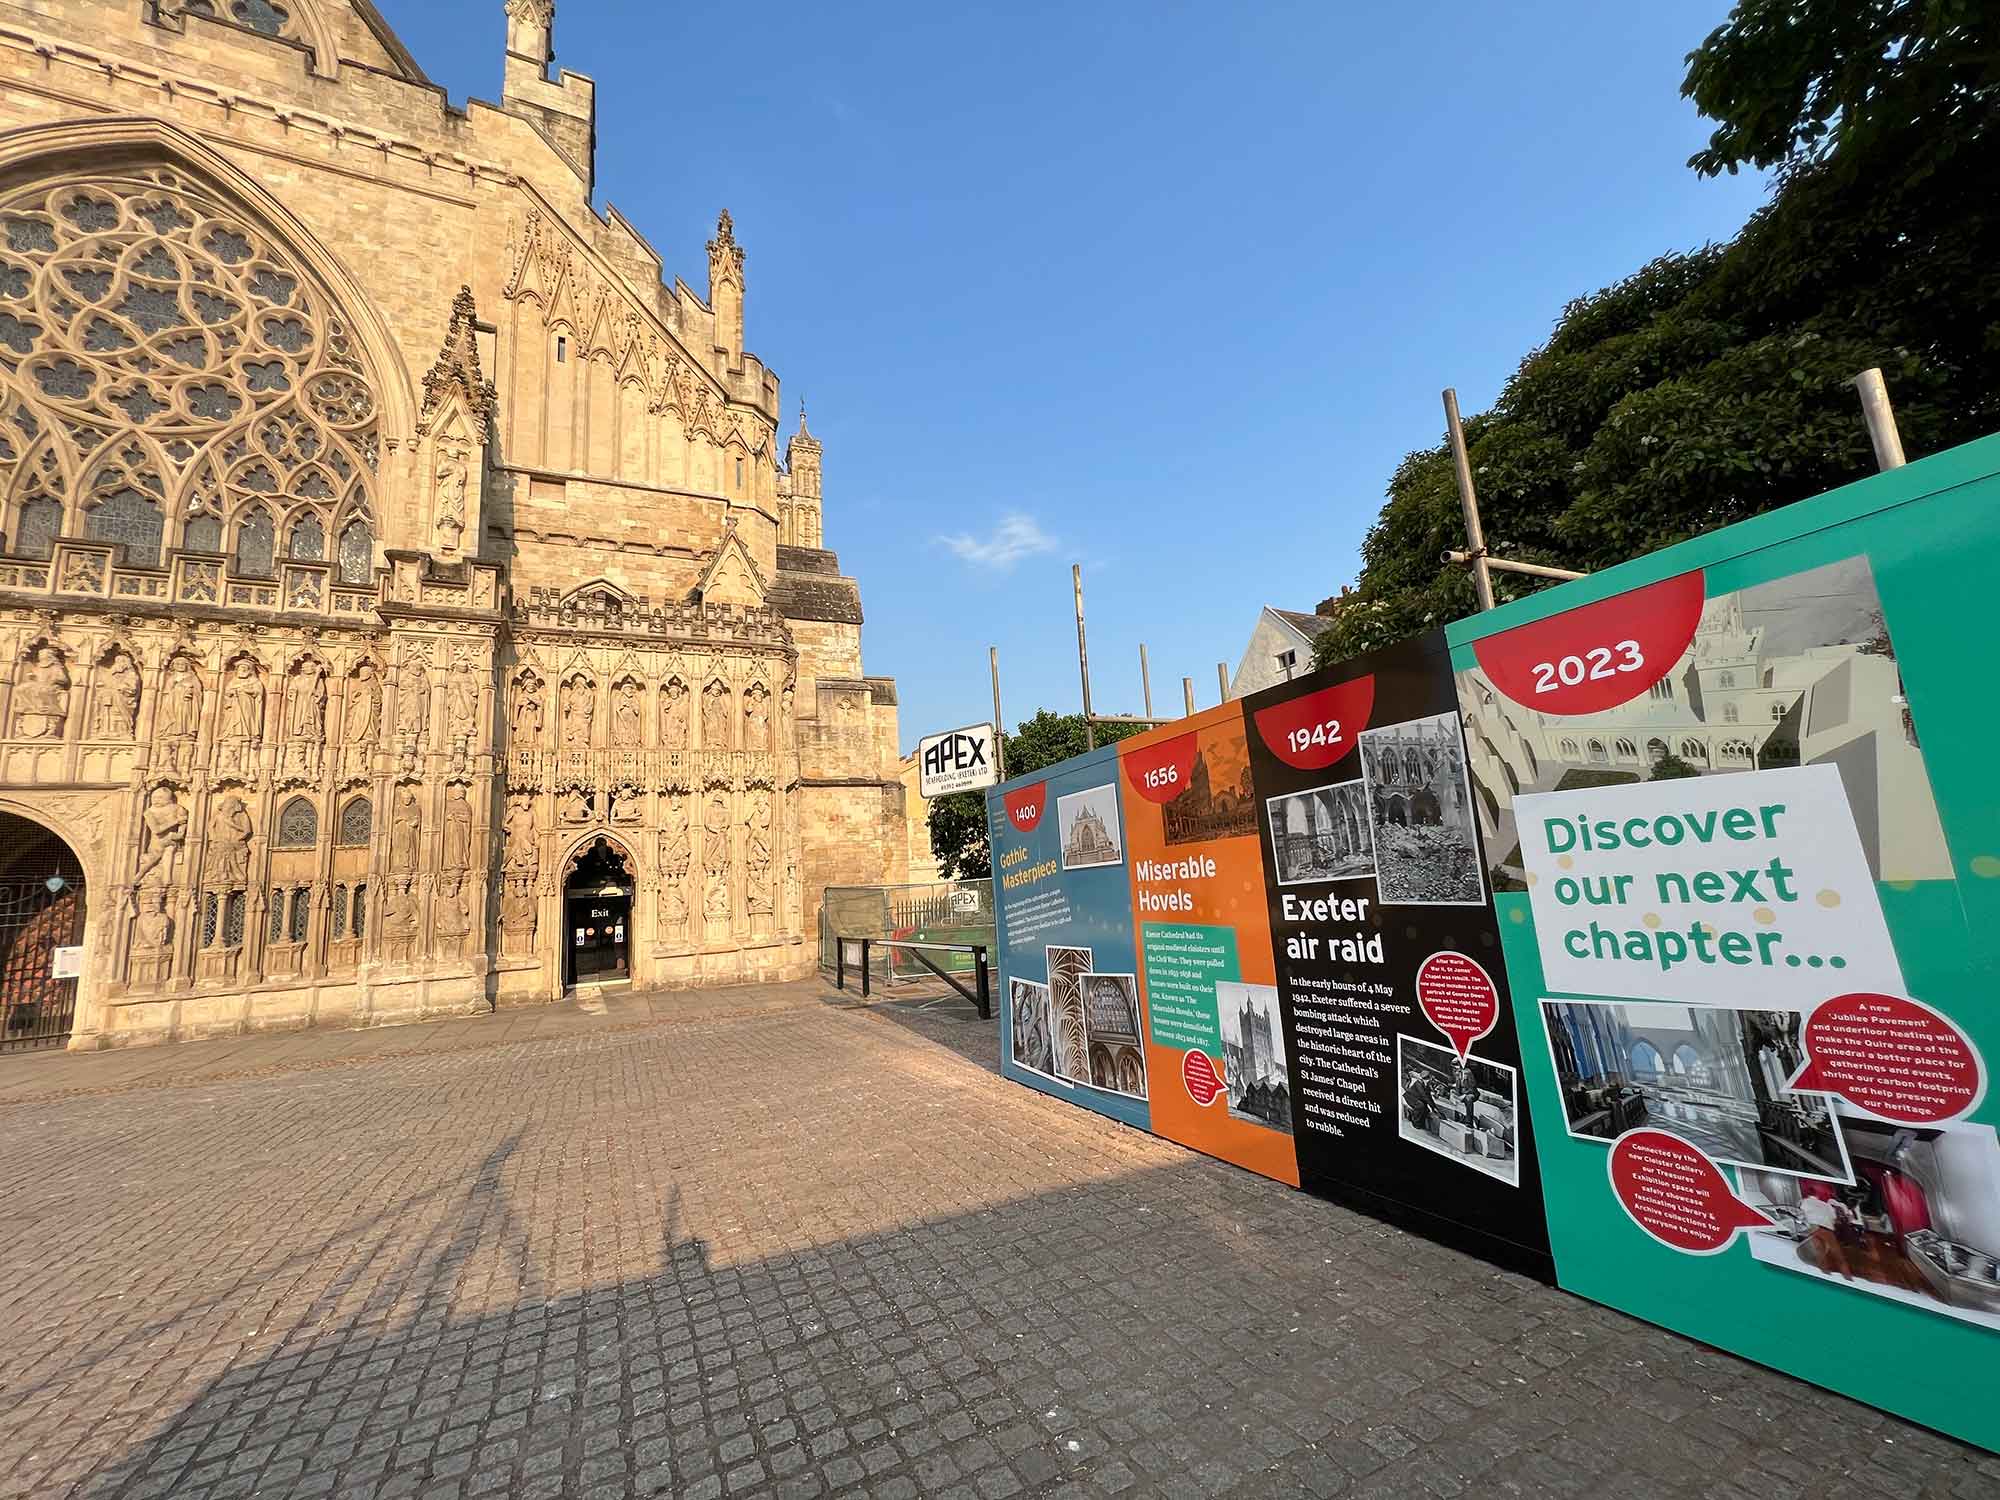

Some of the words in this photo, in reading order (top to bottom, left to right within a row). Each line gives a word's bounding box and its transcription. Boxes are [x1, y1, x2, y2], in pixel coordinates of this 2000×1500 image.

[1530, 639, 1645, 694] 2023
[1288, 720, 1342, 752] 1942
[925, 734, 986, 776] APEX
[978, 767, 987, 775] LTD
[1144, 765, 1178, 788] 1656
[1015, 805, 1036, 822] 1400
[1544, 802, 1786, 854] Discover
[1000, 845, 1028, 869] Gothic
[1136, 854, 1216, 882] Miserable
[1002, 859, 1057, 889] Masterpiece
[1554, 873, 1633, 906] our
[1656, 856, 1798, 904] next
[951, 893, 976, 906] APEX
[1138, 888, 1192, 912] Hovels
[1282, 892, 1369, 921] Exeter
[592, 909, 609, 918] Exit
[1287, 931, 1319, 960] air
[1328, 932, 1384, 964] raid
[1564, 920, 1846, 972] chapter...
[1290, 976, 1298, 985] In
[1299, 977, 1311, 986] the
[1312, 979, 1331, 990] early
[1332, 980, 1356, 991] hours
[1357, 982, 1367, 992] of
[1368, 986, 1374, 994] 4
[1374, 984, 1393, 996] May
[1292, 993, 1311, 1003] 1942,
[1312, 994, 1337, 1005] Exeter
[1338, 997, 1373, 1010] suffered
[1381, 1004, 1410, 1014] severe
[1293, 1006, 1327, 1022] bombing
[1327, 1013, 1352, 1024] attack
[1353, 1015, 1380, 1027] which
[1296, 1022, 1332, 1037] destroyed
[1333, 1027, 1354, 1042] large
[1355, 1034, 1378, 1044] areas
[1379, 1035, 1389, 1046] in
[1816, 1035, 1842, 1043] make
[1864, 1039, 1894, 1048] Quire
[1897, 1044, 1922, 1052] area
[1924, 1045, 1936, 1053] of
[1938, 1046, 1959, 1055] the
[1833, 1026, 1887, 1035] underfloor
[1890, 1029, 1933, 1042] heating
[1935, 1034, 1956, 1042] will
[1297, 1038, 1310, 1049] the
[1310, 1040, 1341, 1054] historic
[1341, 1045, 1365, 1059] heart
[1366, 1050, 1375, 1060] of
[1376, 1052, 1392, 1064] the
[1816, 1046, 1865, 1058] Cathedral
[1877, 1053, 1911, 1063] better
[1915, 1057, 1945, 1066] place
[1948, 1060, 1966, 1068] for
[1299, 1054, 1315, 1067] city.
[1315, 1057, 1331, 1069] The
[1332, 1060, 1378, 1078] Cathedral's
[1830, 1060, 1886, 1073] gatherings
[1889, 1067, 1909, 1075] and
[1301, 1070, 1309, 1080] St
[1310, 1072, 1335, 1085] James'
[1337, 1078, 1366, 1093] Chapel
[1822, 1071, 1854, 1080] shrink
[1877, 1078, 1915, 1088] carbon
[1918, 1081, 1971, 1095] footprint
[1303, 1087, 1335, 1102] received
[1342, 1095, 1367, 1110] direct
[1368, 1100, 1382, 1114] hit
[1849, 1086, 1868, 1094] and
[1870, 1088, 1893, 1098] help
[1895, 1092, 1945, 1104] preserve
[1305, 1104, 1320, 1114] and
[1320, 1107, 1335, 1118] was
[1336, 1112, 1370, 1128] reduced
[1884, 1102, 1936, 1115] heritage.
[1306, 1118, 1314, 1128] to
[1315, 1122, 1344, 1137] rubble.
[1632, 1144, 1671, 1157] Connected
[1672, 1152, 1682, 1160] by
[1684, 1155, 1697, 1163] the
[1644, 1156, 1673, 1167] Cloister
[1632, 1172, 1670, 1187] Exhibition
[1671, 1183, 1694, 1193] space
[1695, 1189, 1710, 1197] will
[1656, 1168, 1695, 1183] Treasures
[1635, 1193, 1676, 1210] fascinating
[1678, 1205, 1707, 1219] Library
[1641, 1186, 1664, 1196] safely
[1665, 1192, 1703, 1206] showcase
[1635, 1203, 1662, 1215] Archive
[1664, 1212, 1706, 1228] collections
[1644, 1216, 1677, 1230] everyone
